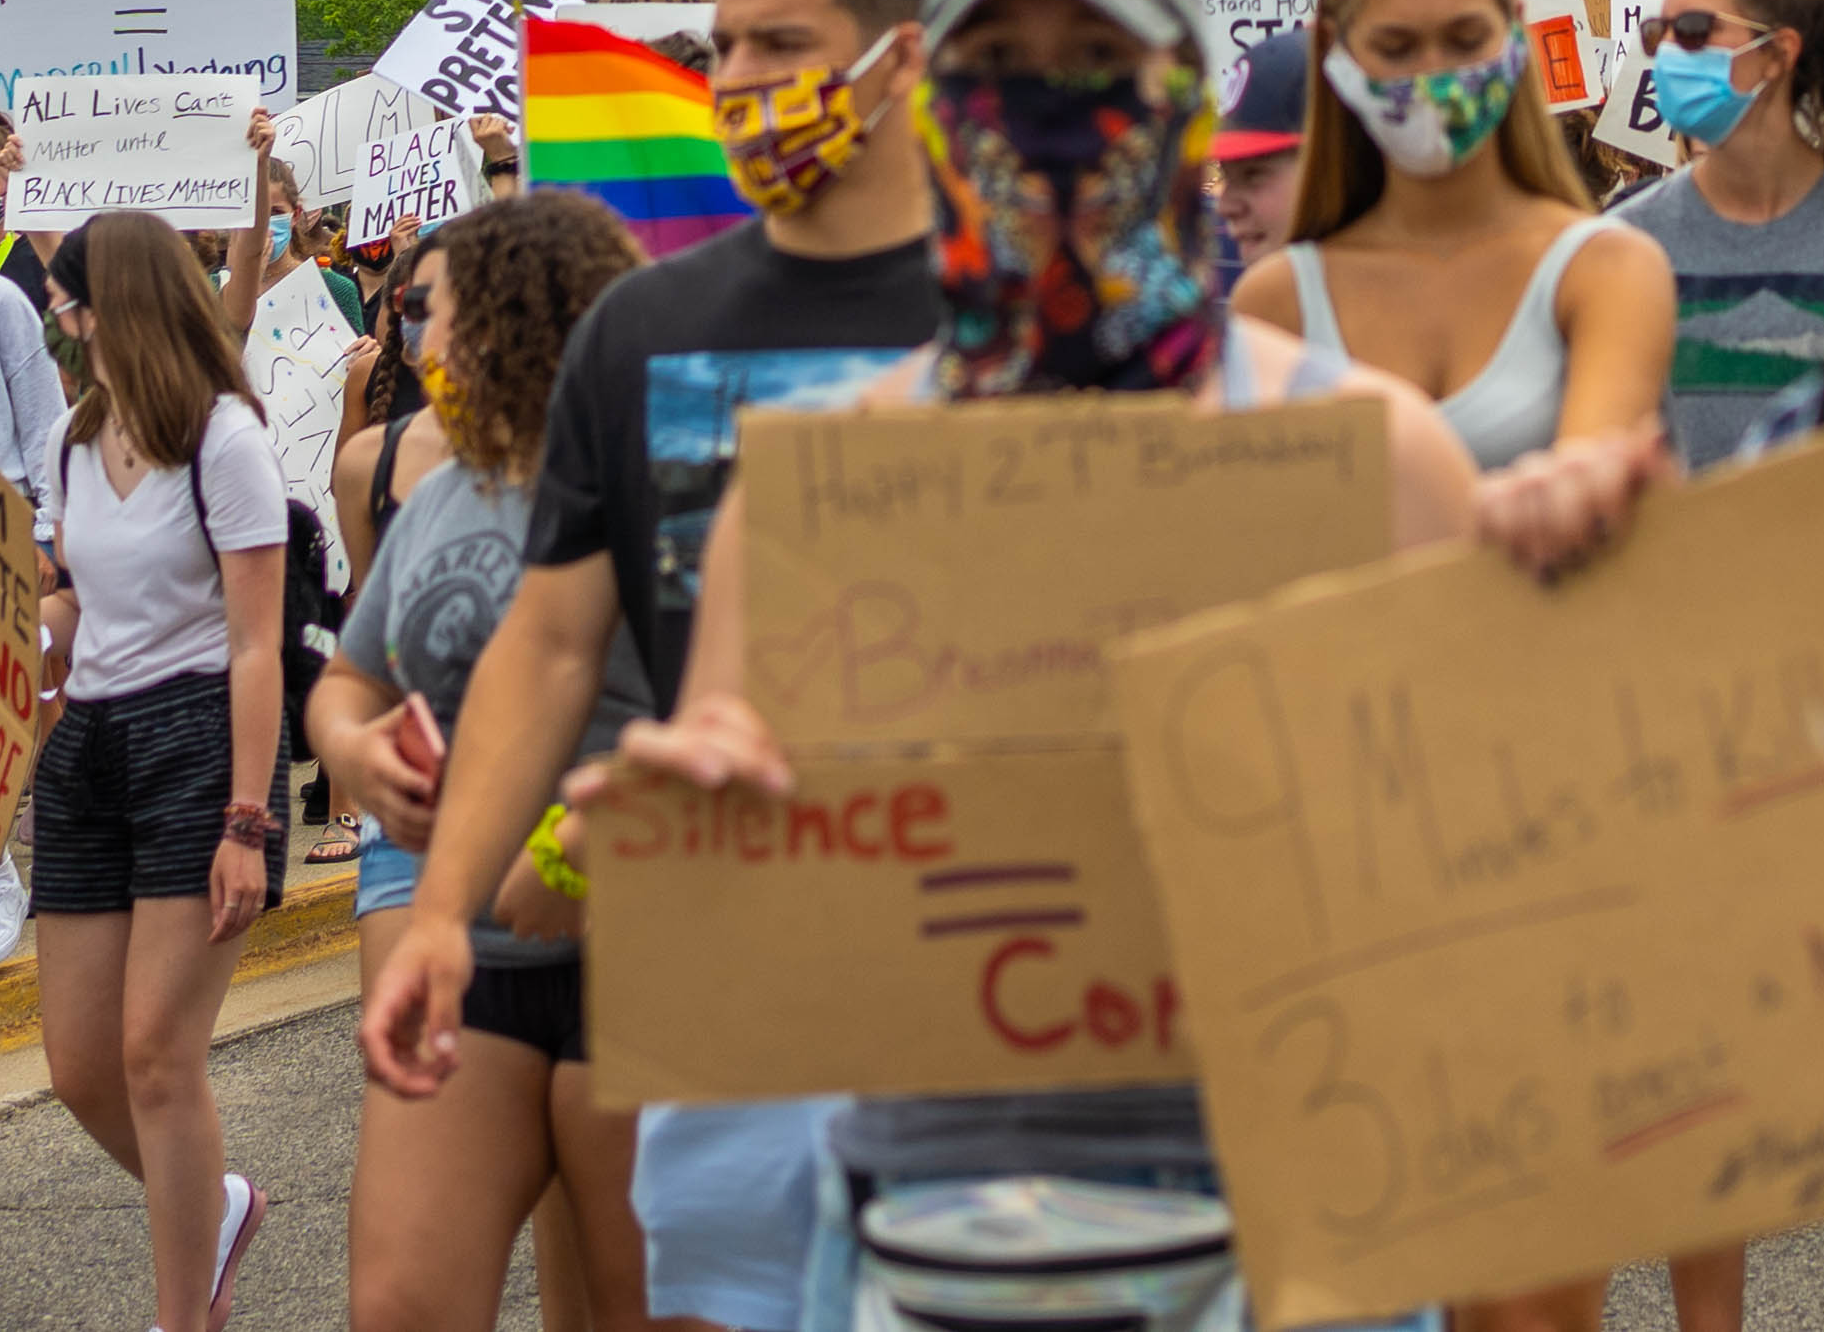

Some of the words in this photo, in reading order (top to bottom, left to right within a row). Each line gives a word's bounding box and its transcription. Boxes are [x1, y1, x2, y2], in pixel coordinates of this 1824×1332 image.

[23, 90, 76, 123] ALL
[92, 88, 161, 117] Lives
[174, 91, 234, 114] Can't
[116, 130, 171, 153] until
[368, 120, 464, 178] BLACK
[23, 177, 96, 206] BLACK
[103, 179, 165, 205] LIVES
[387, 160, 441, 196] LIVES
[362, 180, 458, 239] MATTER
